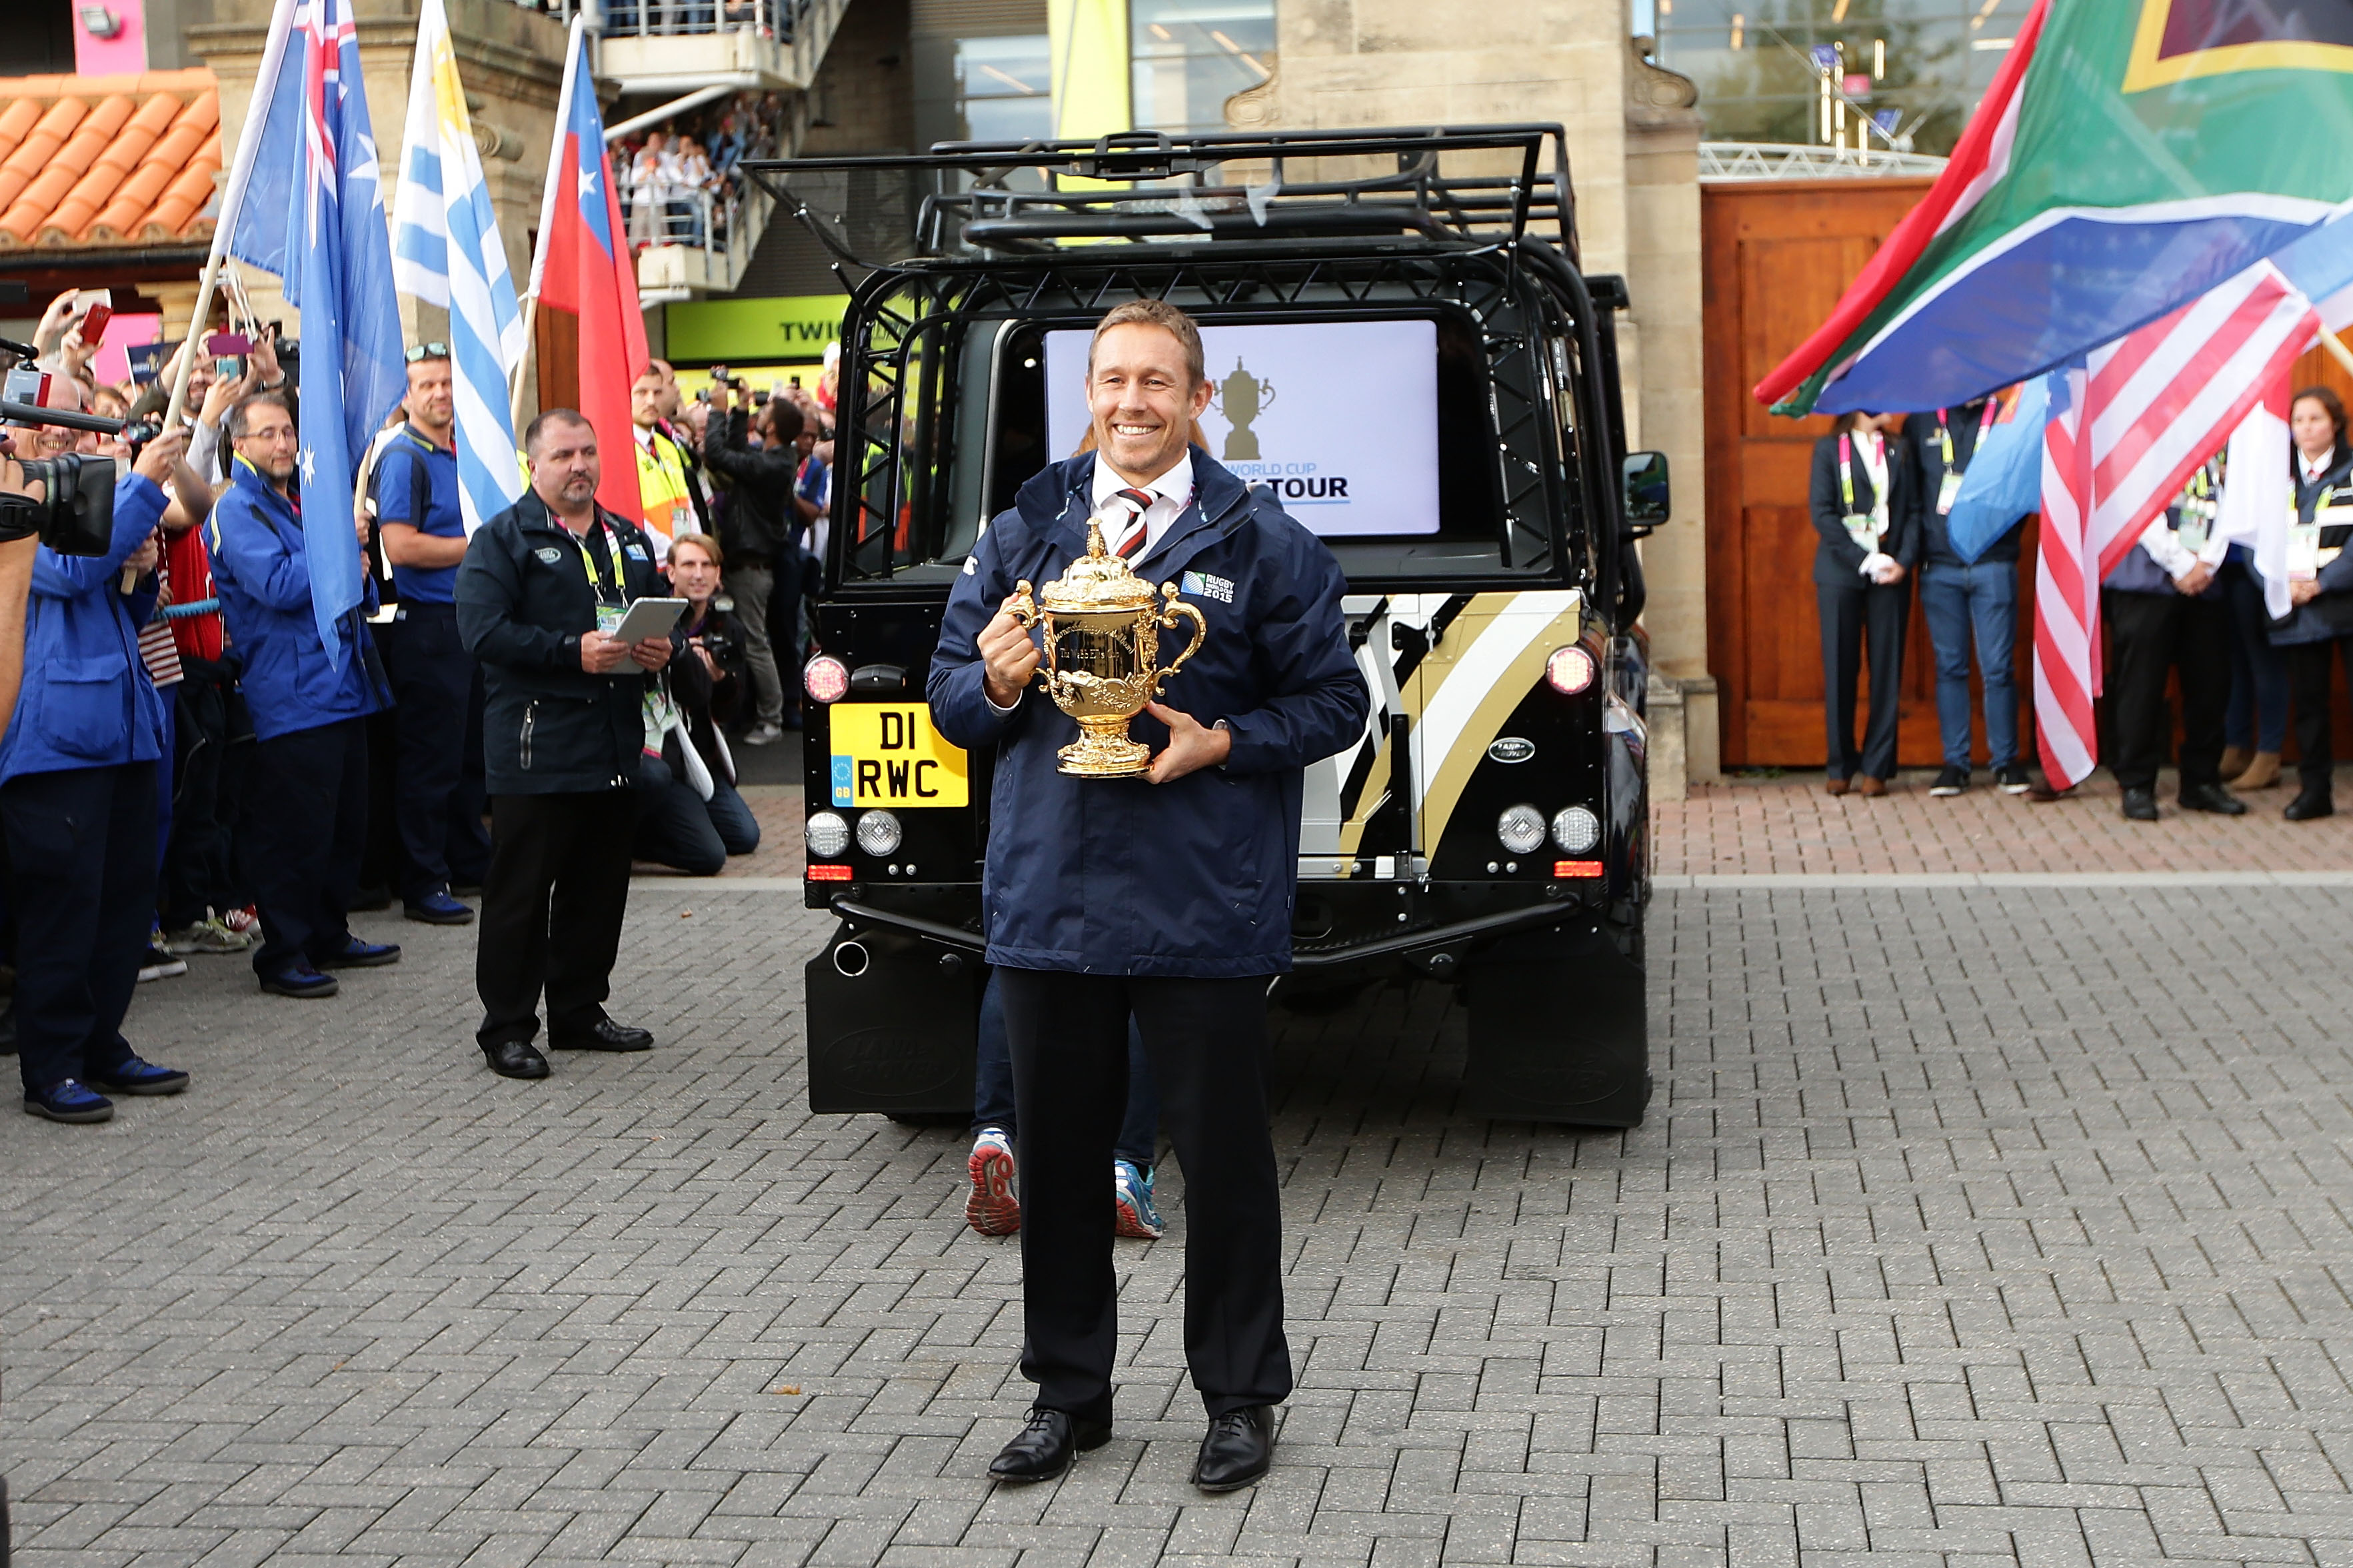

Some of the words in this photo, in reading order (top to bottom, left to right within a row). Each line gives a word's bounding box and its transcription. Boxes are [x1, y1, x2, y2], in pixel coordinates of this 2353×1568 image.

[780, 320, 841, 341] TWI
[1227, 463, 1281, 476] WORLD
[1286, 462, 1317, 475] CUP
[1266, 477, 1349, 498] TOUR
[1205, 582, 1224, 592] WORLD
[1206, 574, 1234, 590] RUGBY
[1203, 588, 1233, 603] 2015
[858, 760, 939, 798] RWC
[836, 786, 850, 798] GB
